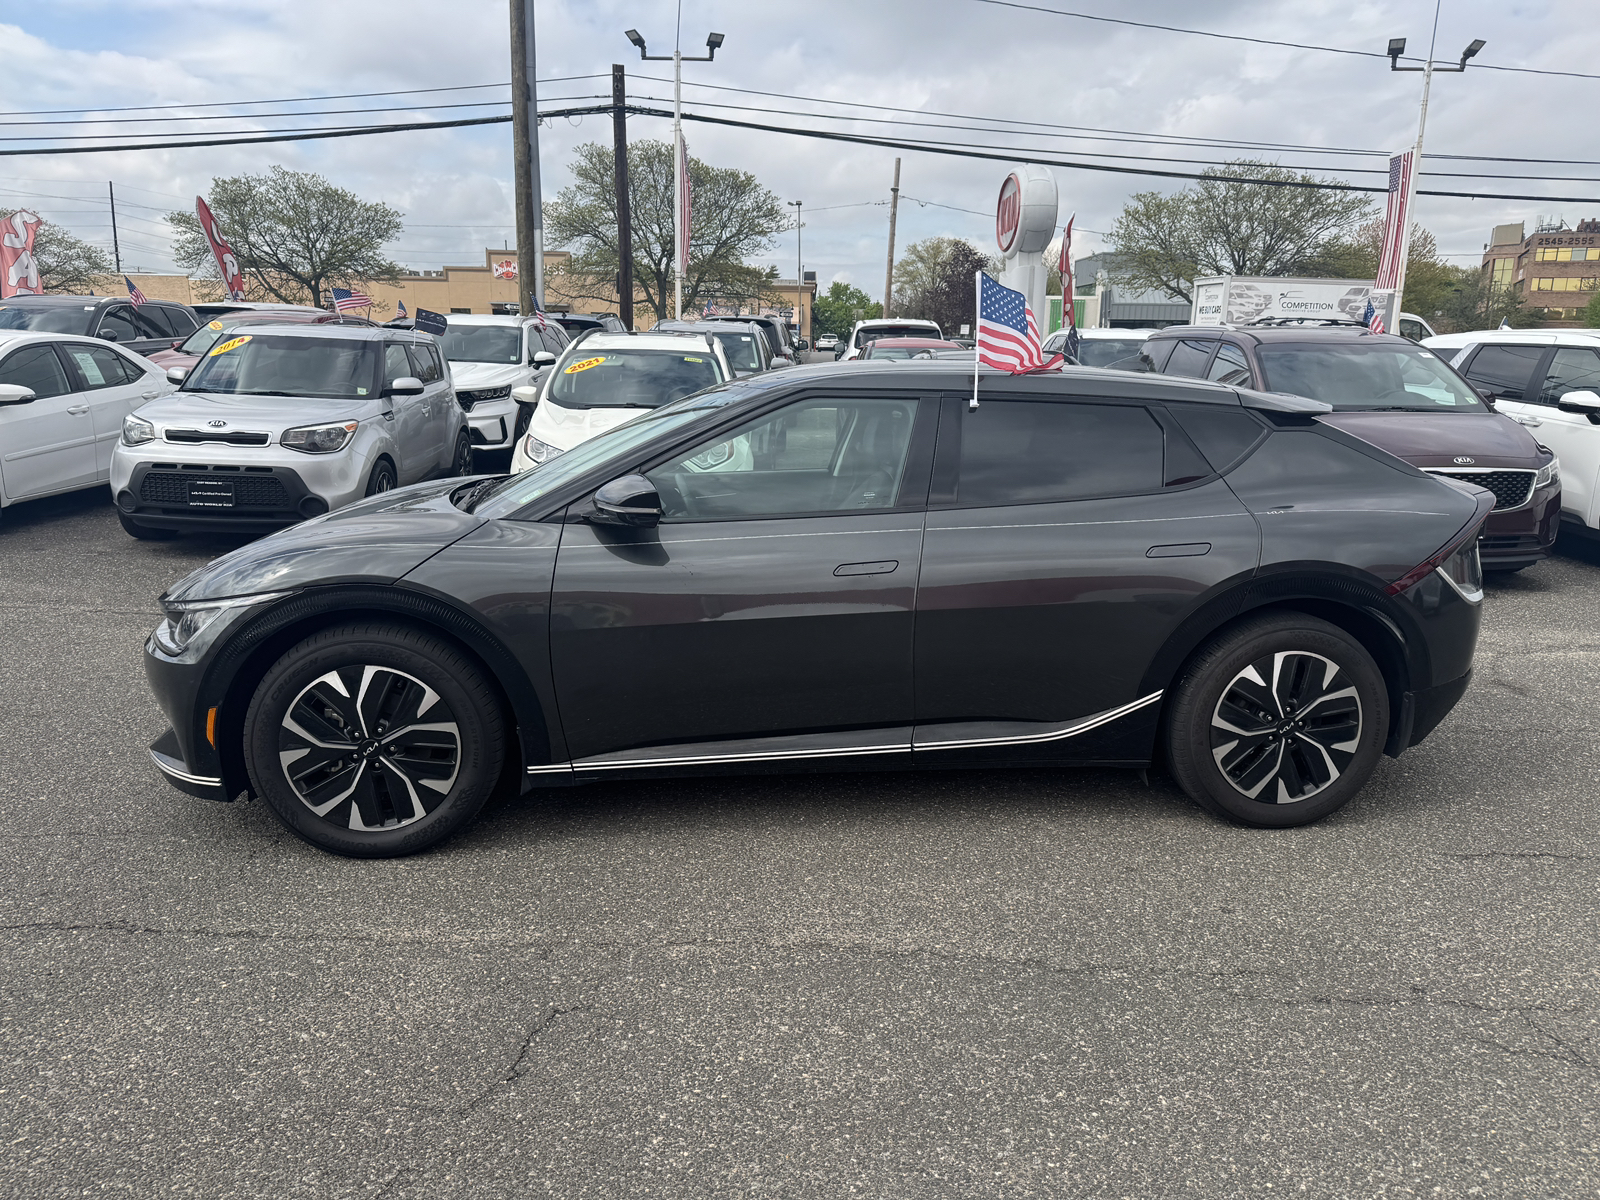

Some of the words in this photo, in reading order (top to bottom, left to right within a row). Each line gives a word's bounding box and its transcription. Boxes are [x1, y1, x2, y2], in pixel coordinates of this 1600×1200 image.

[1538, 237, 1595, 246] 2545-2555
[1199, 305, 1205, 314] WE
[1212, 304, 1221, 313] CARS
[1281, 301, 1334, 310] COMPETITION
[570, 357, 600, 372] 2021
